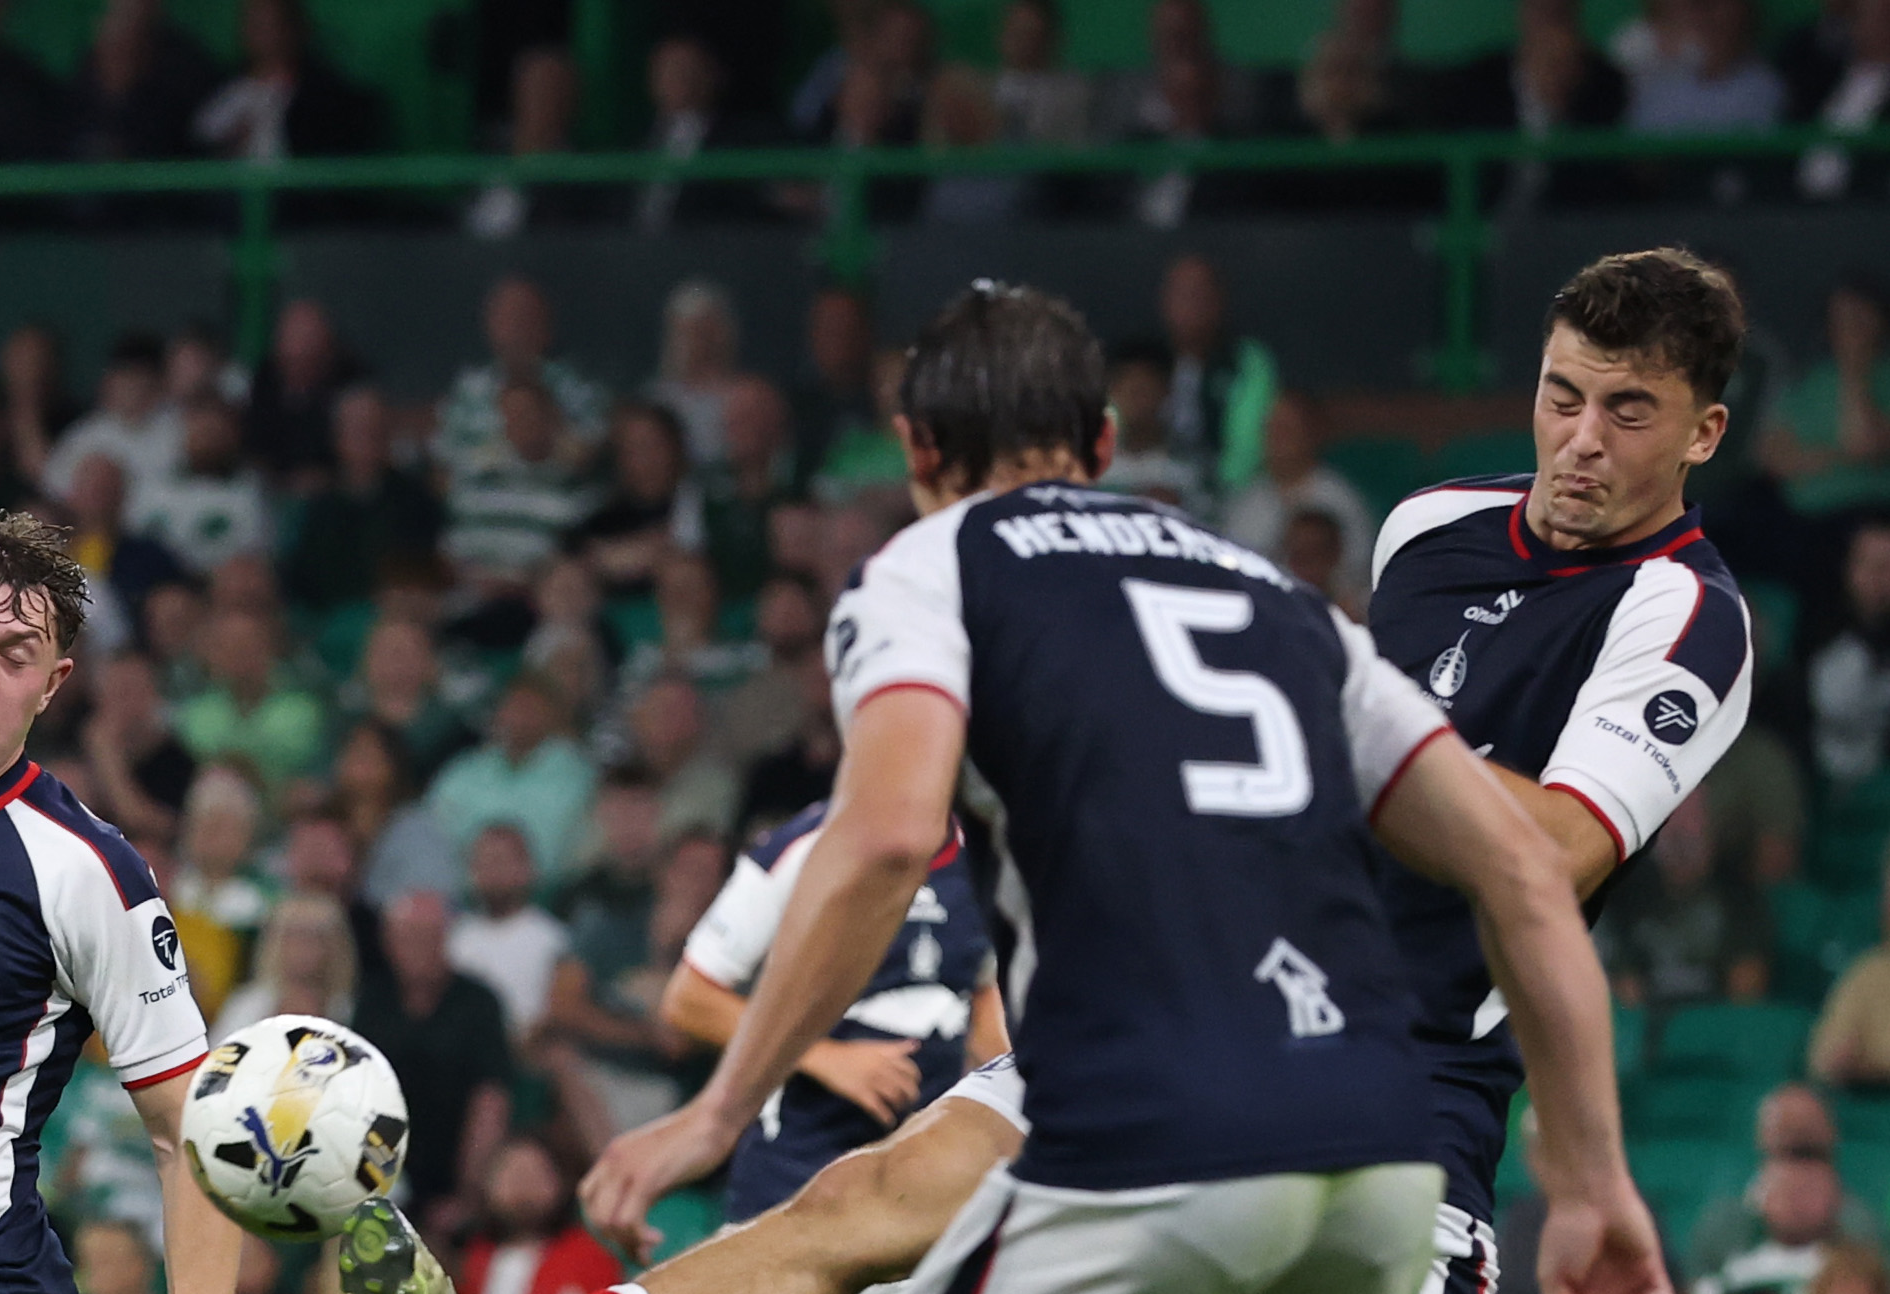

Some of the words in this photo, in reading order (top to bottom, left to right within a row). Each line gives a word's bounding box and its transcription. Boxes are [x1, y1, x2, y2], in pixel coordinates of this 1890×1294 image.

[1120, 577, 1313, 817] 5
[1594, 716, 1640, 745] Total
[138, 981, 176, 1005] Total
